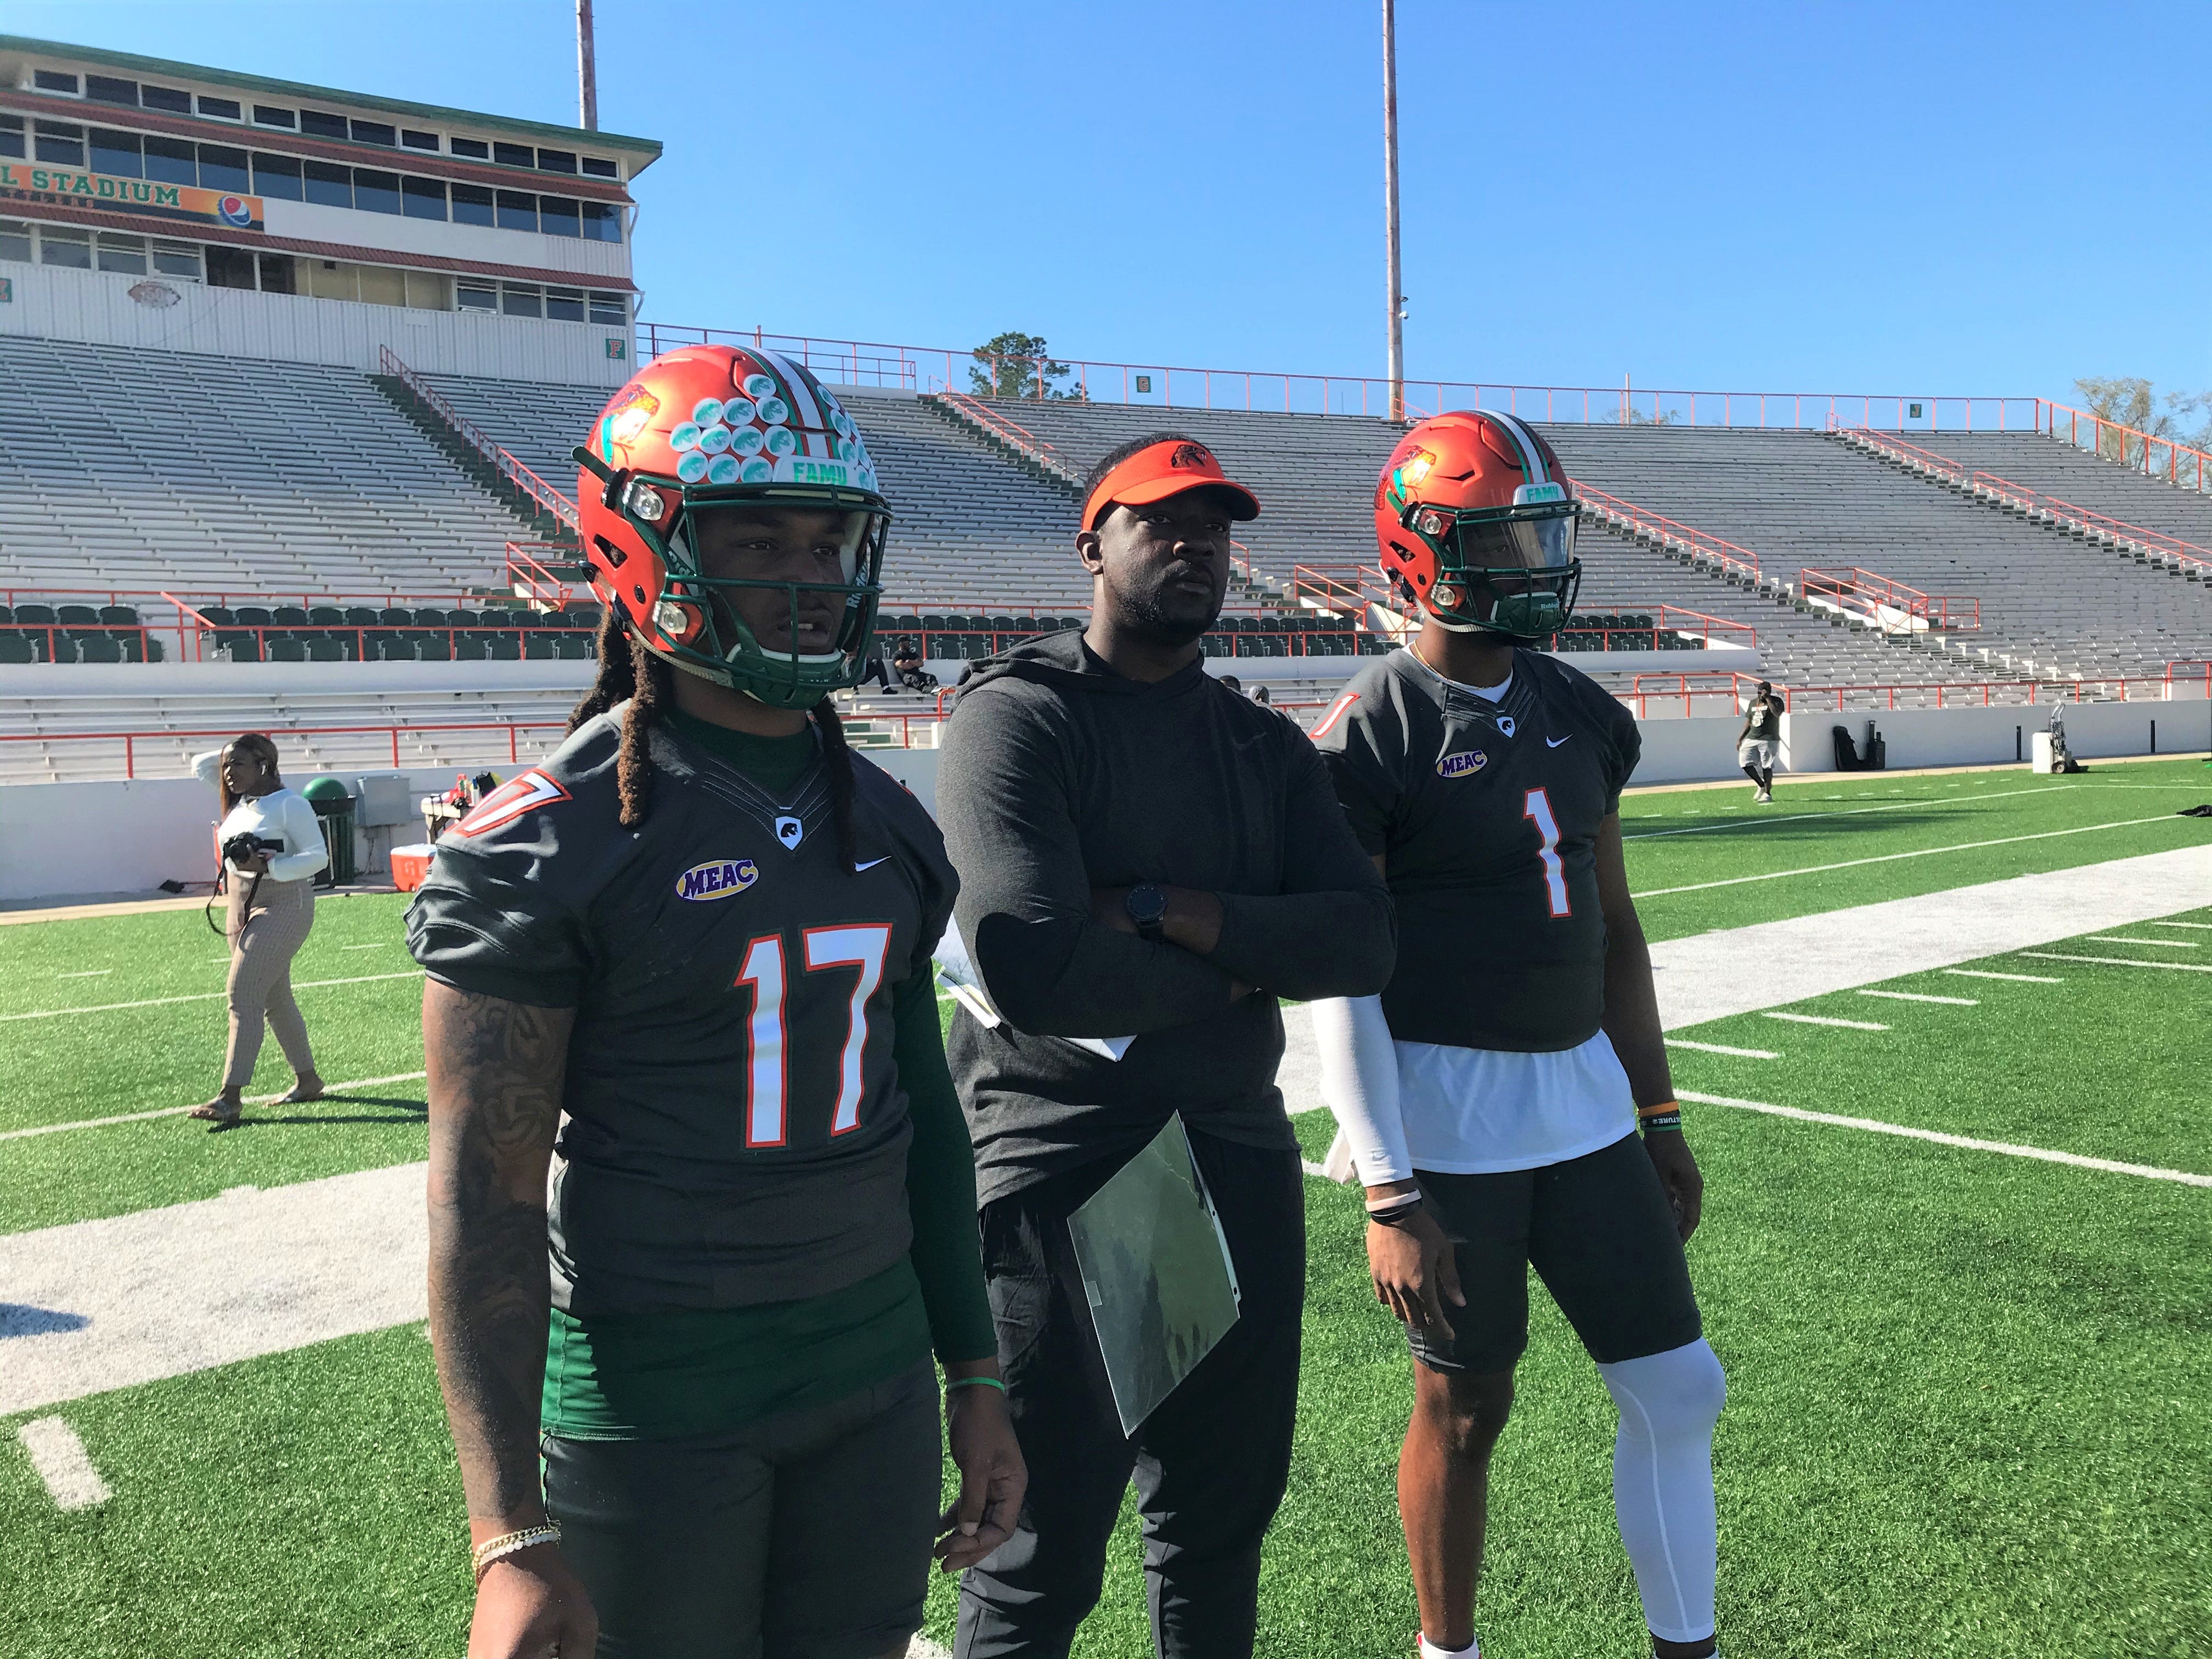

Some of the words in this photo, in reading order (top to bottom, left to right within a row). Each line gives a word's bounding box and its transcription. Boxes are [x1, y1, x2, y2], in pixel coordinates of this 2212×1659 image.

[31, 168, 180, 207] STADIUM
[609, 340, 622, 357] F
[1138, 377, 1149, 391] G
[1911, 405, 1920, 416] J
[793, 462, 847, 486] FAMU
[1441, 751, 1485, 777] MEAC
[1523, 786, 1572, 918] 1
[682, 860, 755, 899] MEAC
[733, 923, 893, 1148] 17
